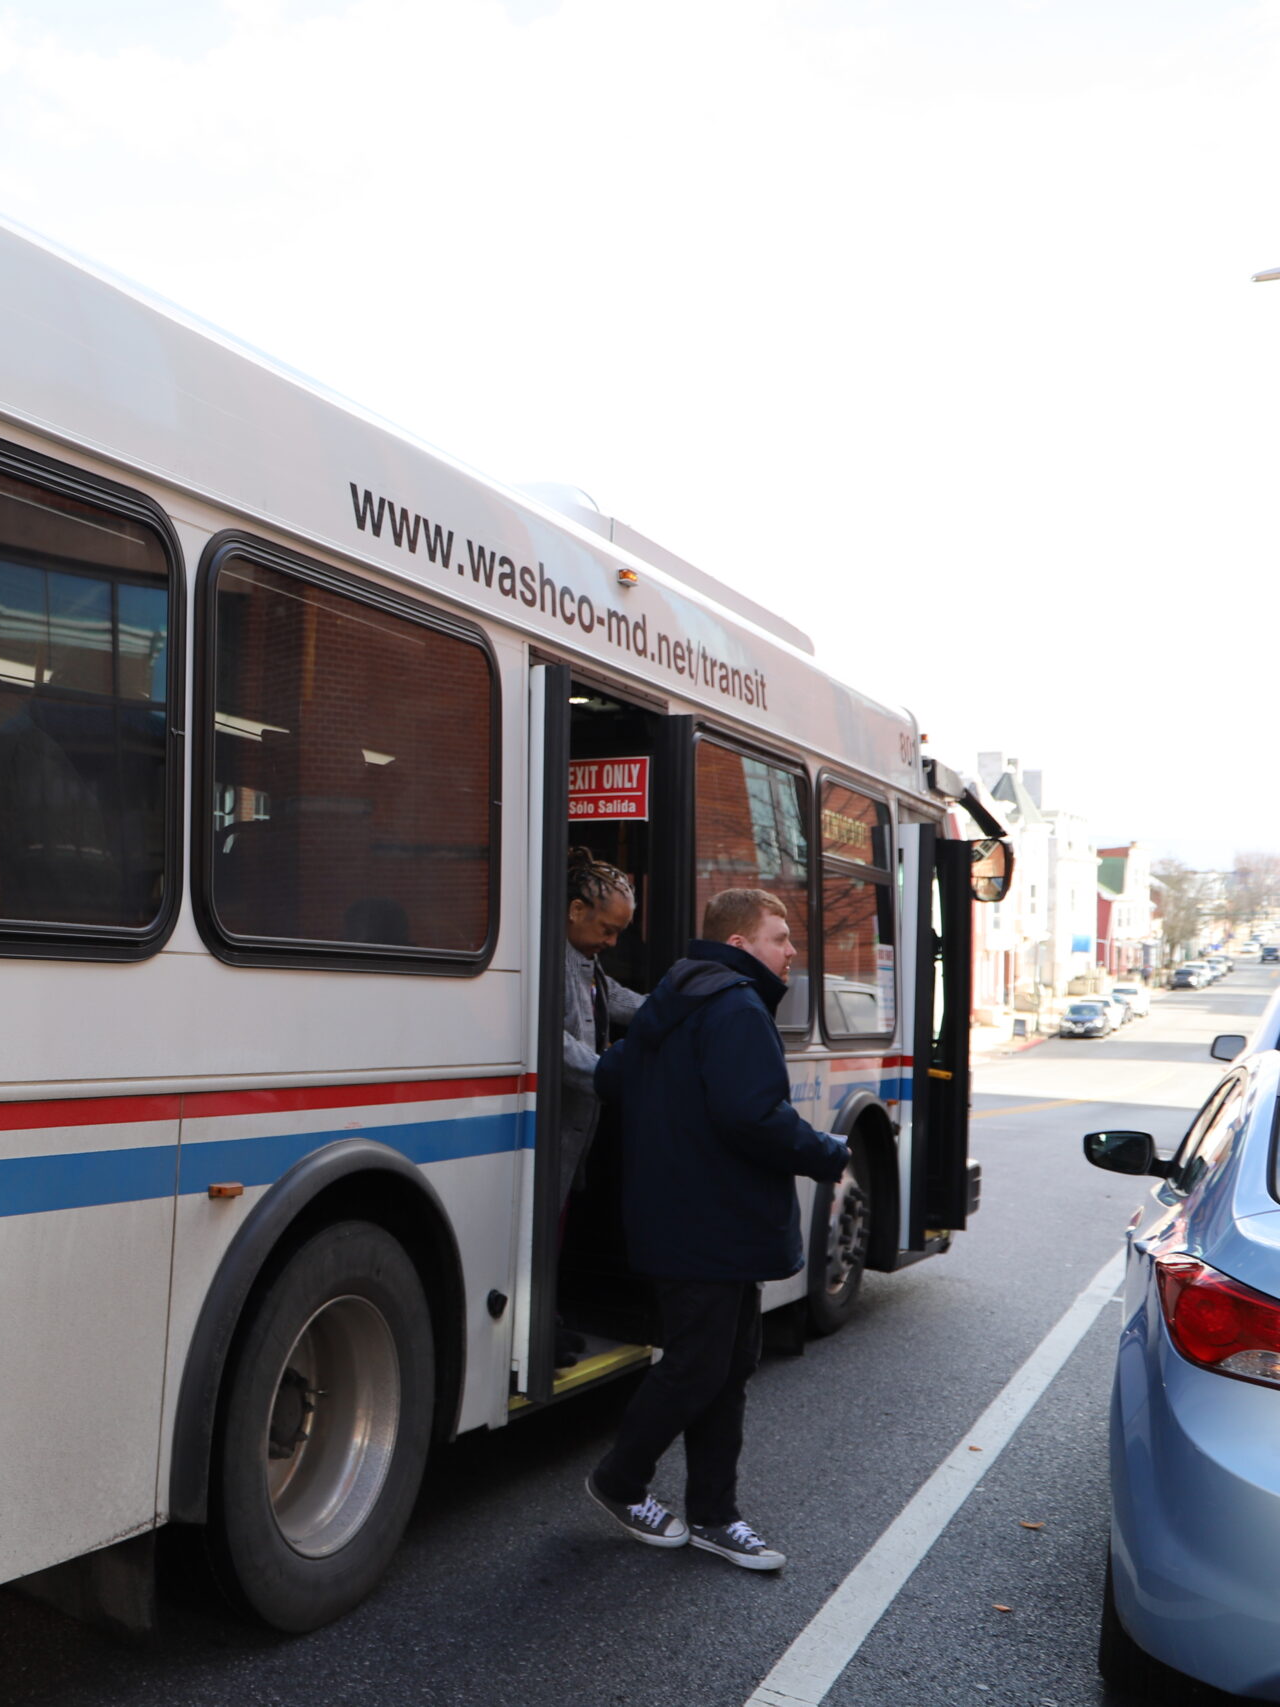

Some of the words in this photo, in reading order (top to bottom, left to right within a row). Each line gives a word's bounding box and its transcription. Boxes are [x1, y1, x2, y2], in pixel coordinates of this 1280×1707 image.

[349, 481, 769, 711] www.washco-md.net/transit
[568, 765, 599, 790] EXIT
[603, 763, 641, 789] ONLY
[569, 800, 595, 815] Sólo
[597, 799, 637, 814] Salida
